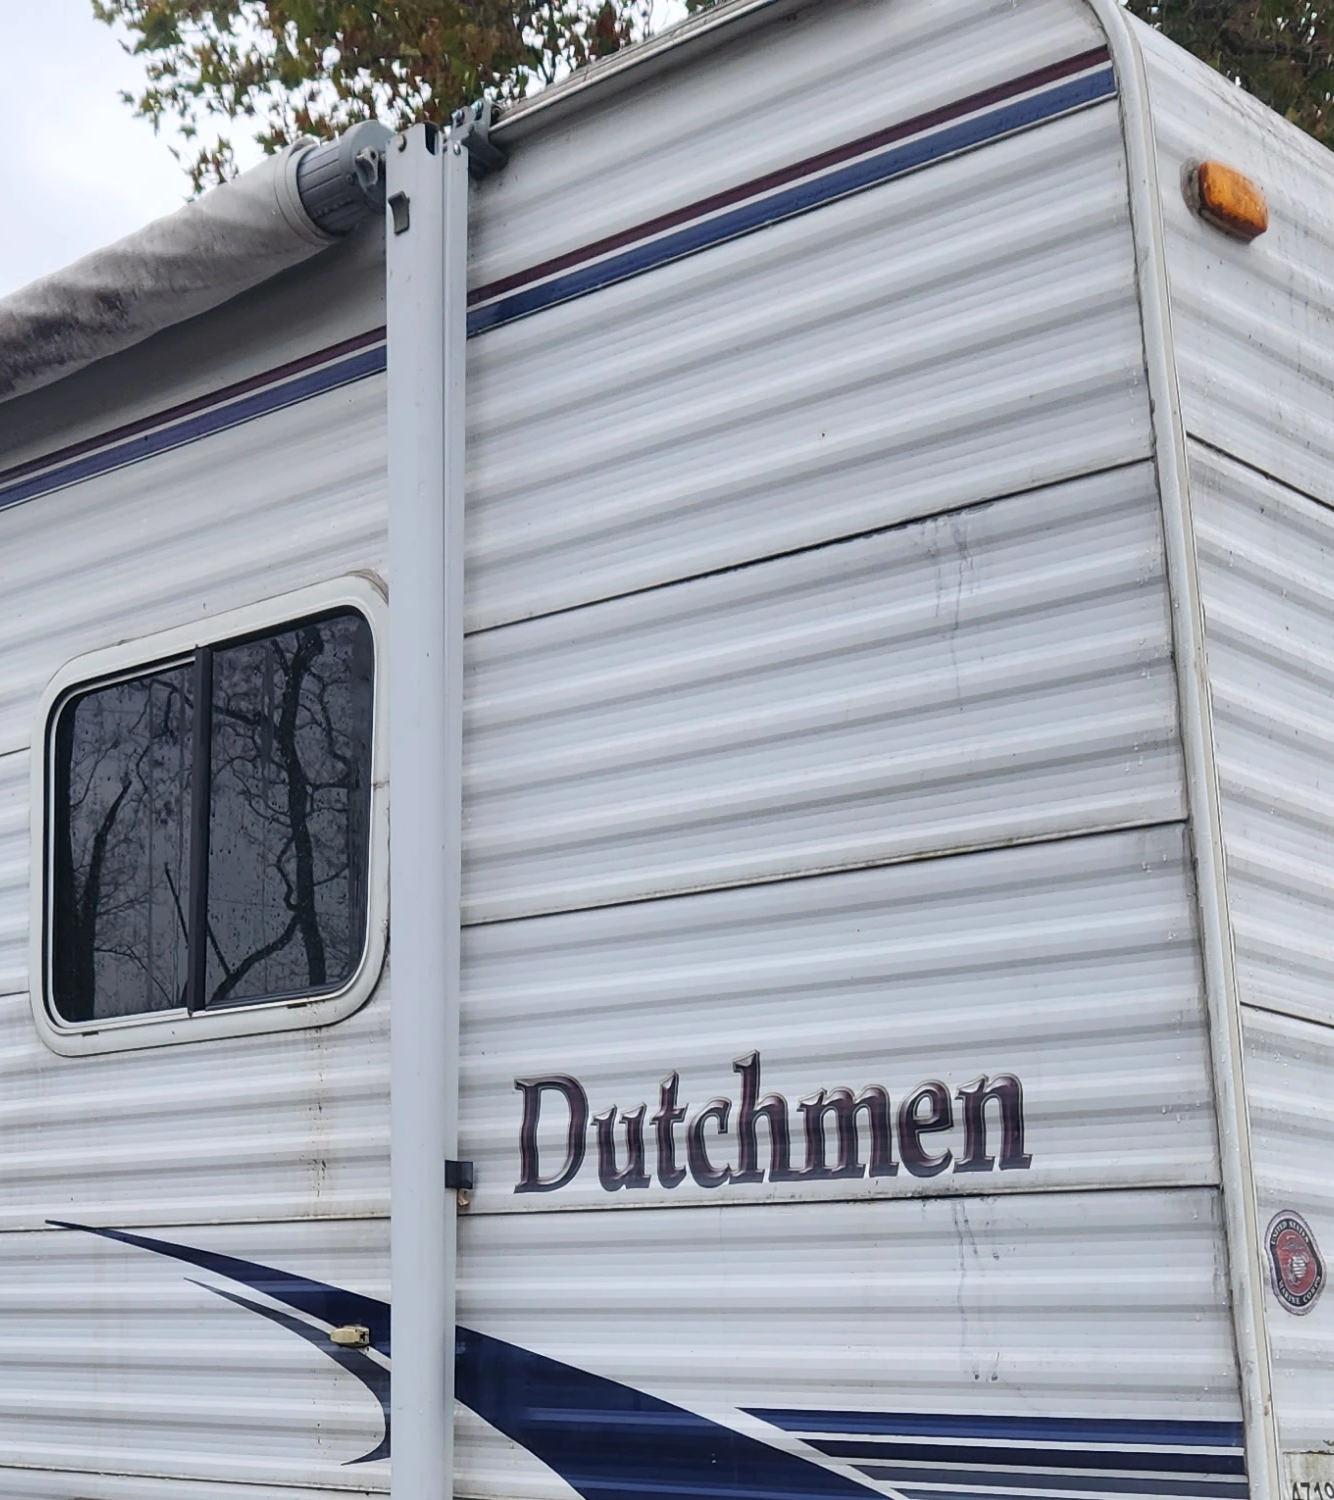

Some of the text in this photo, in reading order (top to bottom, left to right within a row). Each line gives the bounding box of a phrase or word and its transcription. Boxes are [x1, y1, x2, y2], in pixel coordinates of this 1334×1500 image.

[513, 1048, 1033, 1194] Dutchmen
[1278, 1275, 1321, 1305] MARINE CORPS
